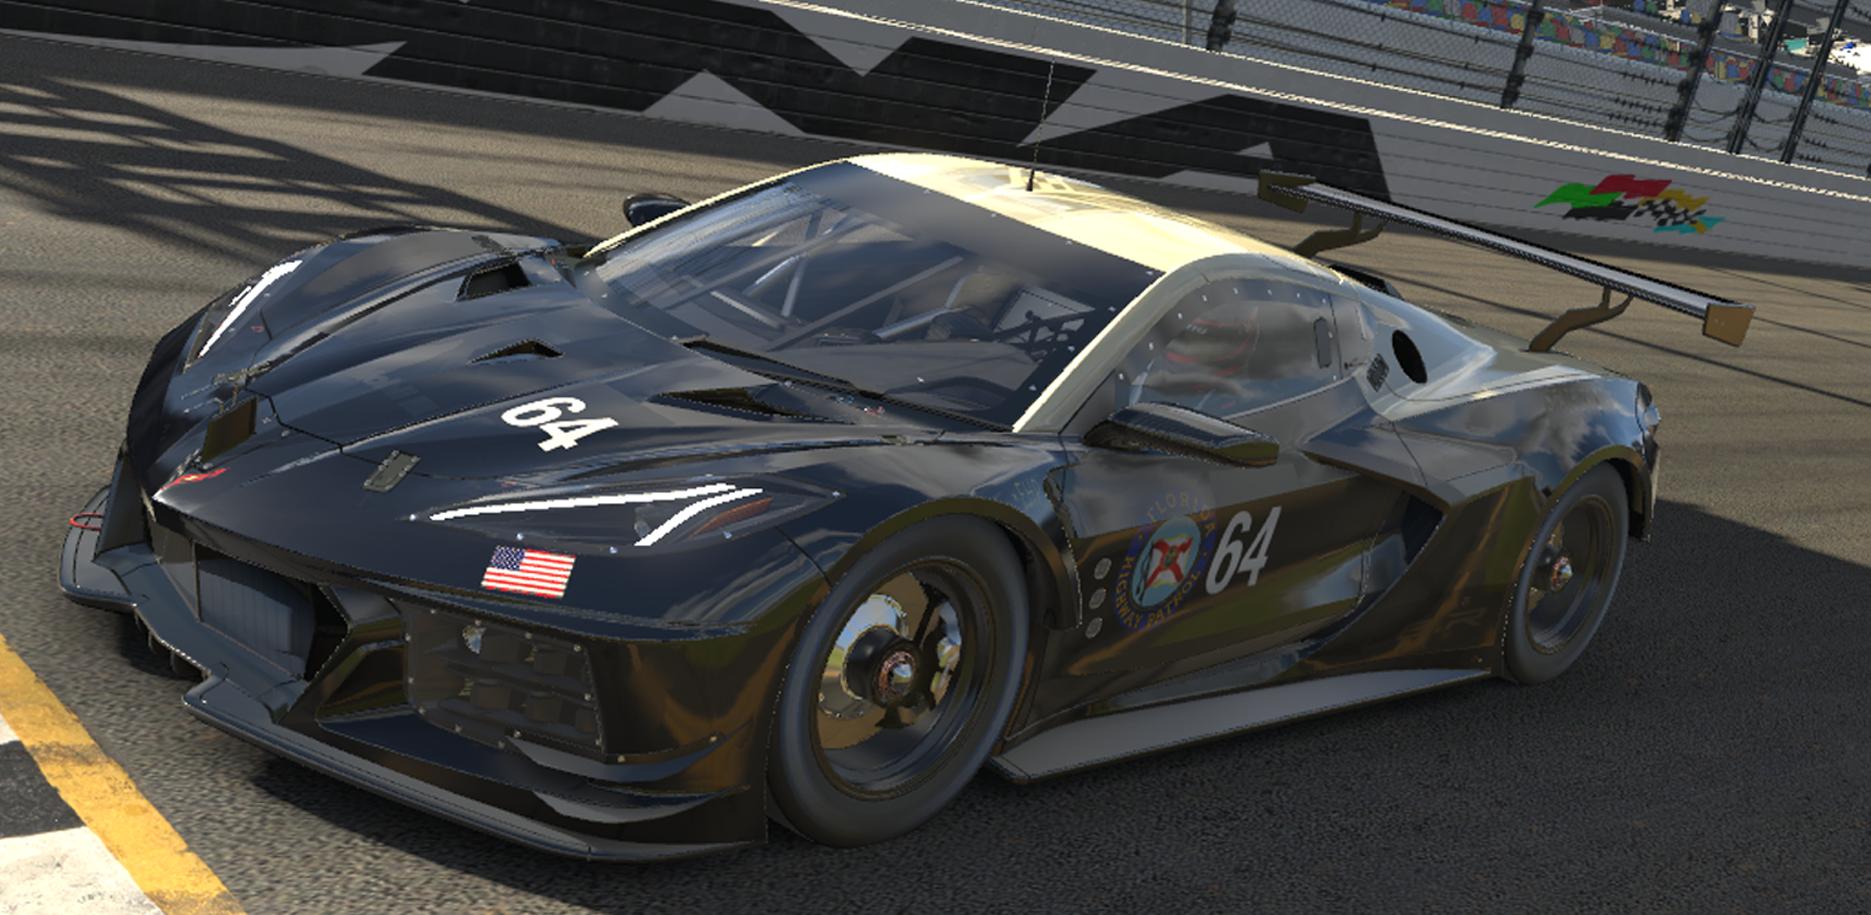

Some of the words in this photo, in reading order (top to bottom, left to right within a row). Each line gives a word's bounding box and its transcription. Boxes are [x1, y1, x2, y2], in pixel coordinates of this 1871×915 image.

[501, 397, 619, 452] 64
[1147, 489, 1217, 536] FLORIDA
[1206, 506, 1282, 595] 64
[1116, 556, 1143, 629] HIGHWAY
[1147, 571, 1201, 627] PATROL
